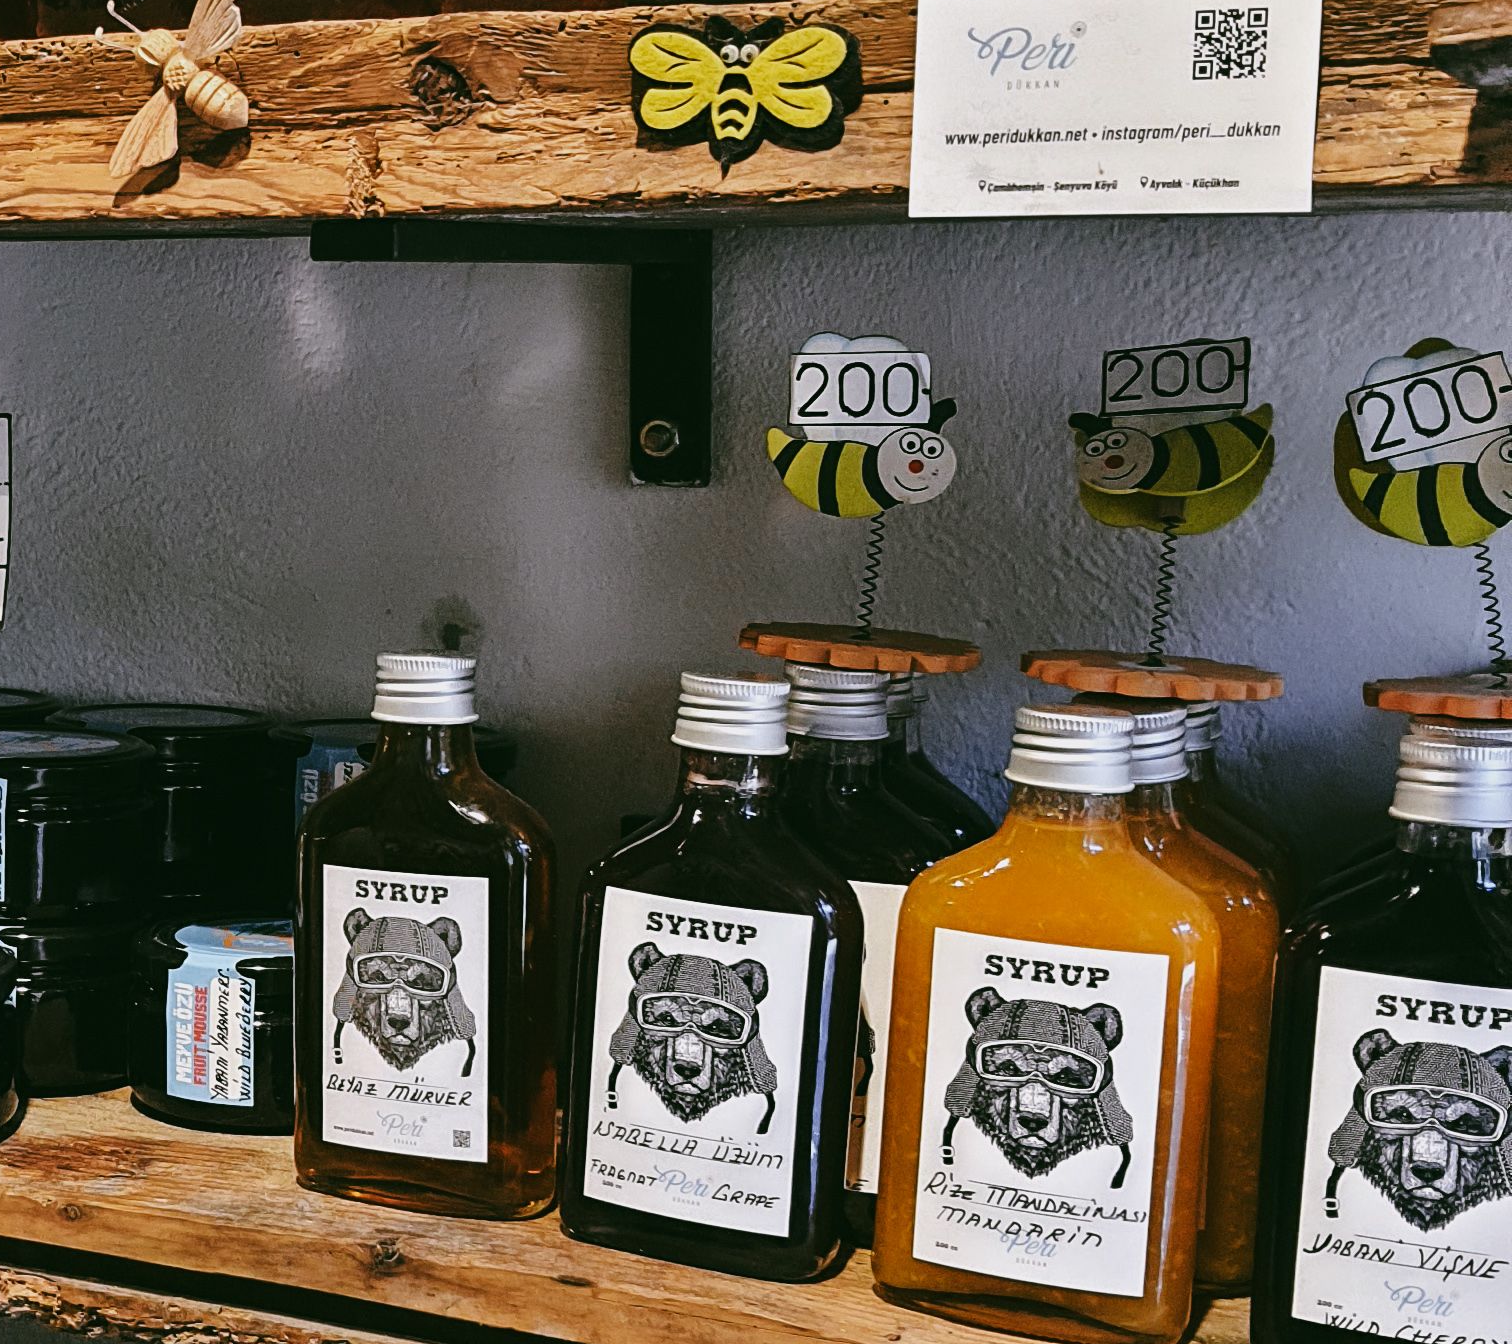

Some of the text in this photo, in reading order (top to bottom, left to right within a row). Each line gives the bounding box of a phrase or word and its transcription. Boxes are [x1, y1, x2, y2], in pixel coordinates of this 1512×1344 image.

[968, 25, 1082, 77] Peri
[944, 127, 1089, 147] www.peridukkan.net
[355, 879, 449, 905] SYRUP
[646, 910, 758, 946] SYRUP
[984, 954, 1110, 989] SYRUP
[1376, 993, 1512, 1031] SYRUP
[173, 982, 194, 1084] MEYVE ÖZÜ
[192, 985, 209, 1087] FRUIT MOUSSE
[326, 1073, 473, 1106] BEYAZ MÜRVER
[376, 1110, 426, 1138] Peri
[712, 1136, 784, 1169] ÜZÜM
[590, 1158, 781, 1209] FRAGNAT GRAPE
[653, 1164, 711, 1198] Peri
[1384, 1280, 1456, 1318] Peri
